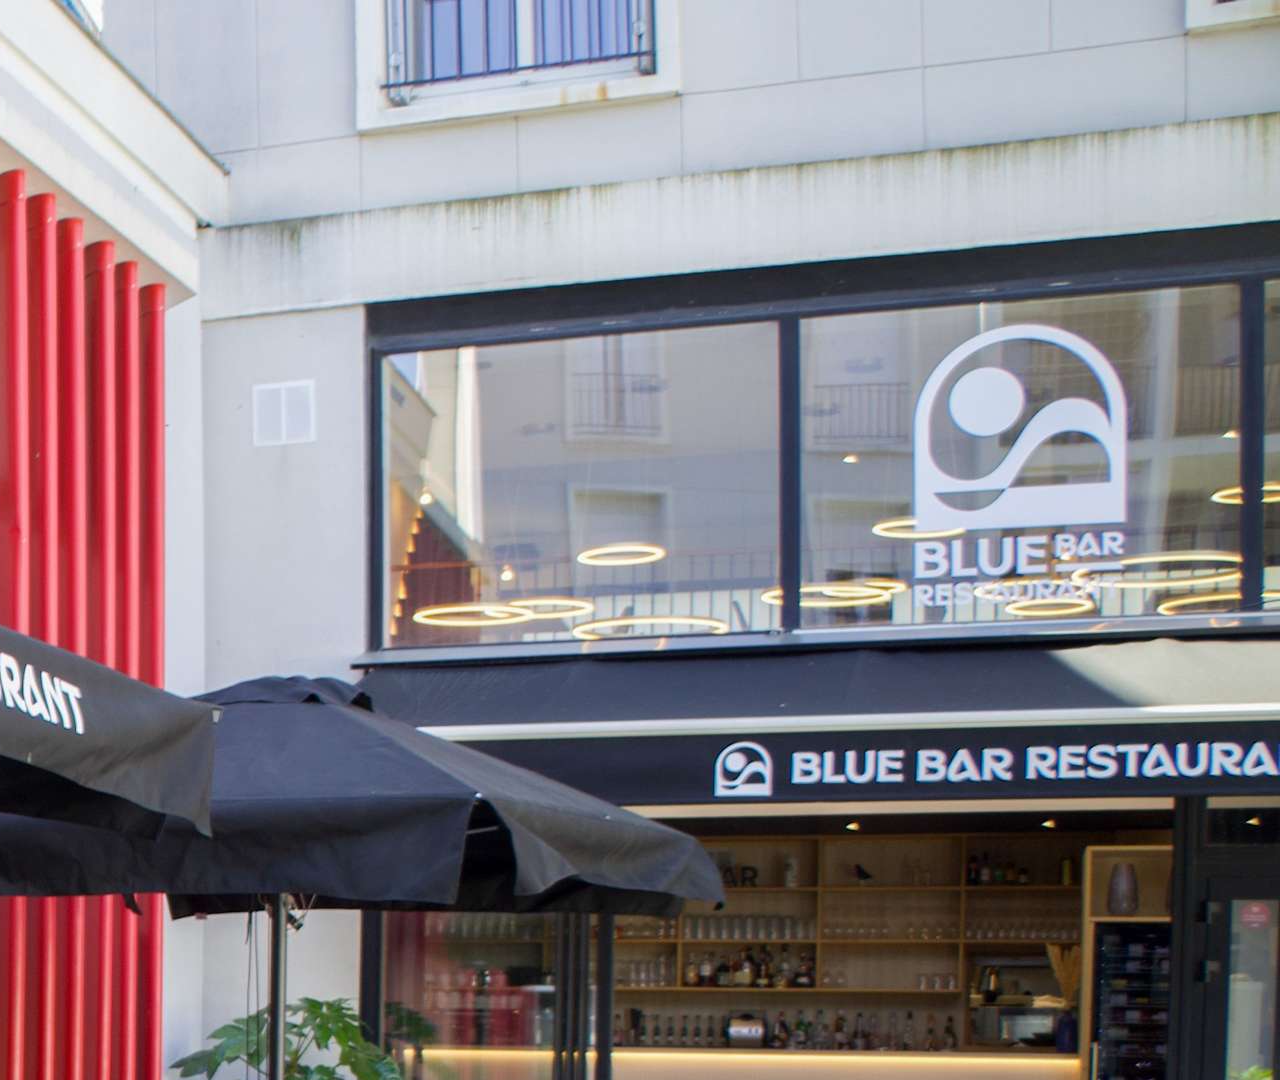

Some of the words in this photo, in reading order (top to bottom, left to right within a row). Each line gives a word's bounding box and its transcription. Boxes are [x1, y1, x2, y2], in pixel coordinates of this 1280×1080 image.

[914, 535, 1049, 579] BLUE
[1054, 531, 1125, 557] BAR
[791, 750, 905, 784] BLUE
[915, 747, 1014, 781] BAR
[1025, 741, 1280, 780] RESTAURA
